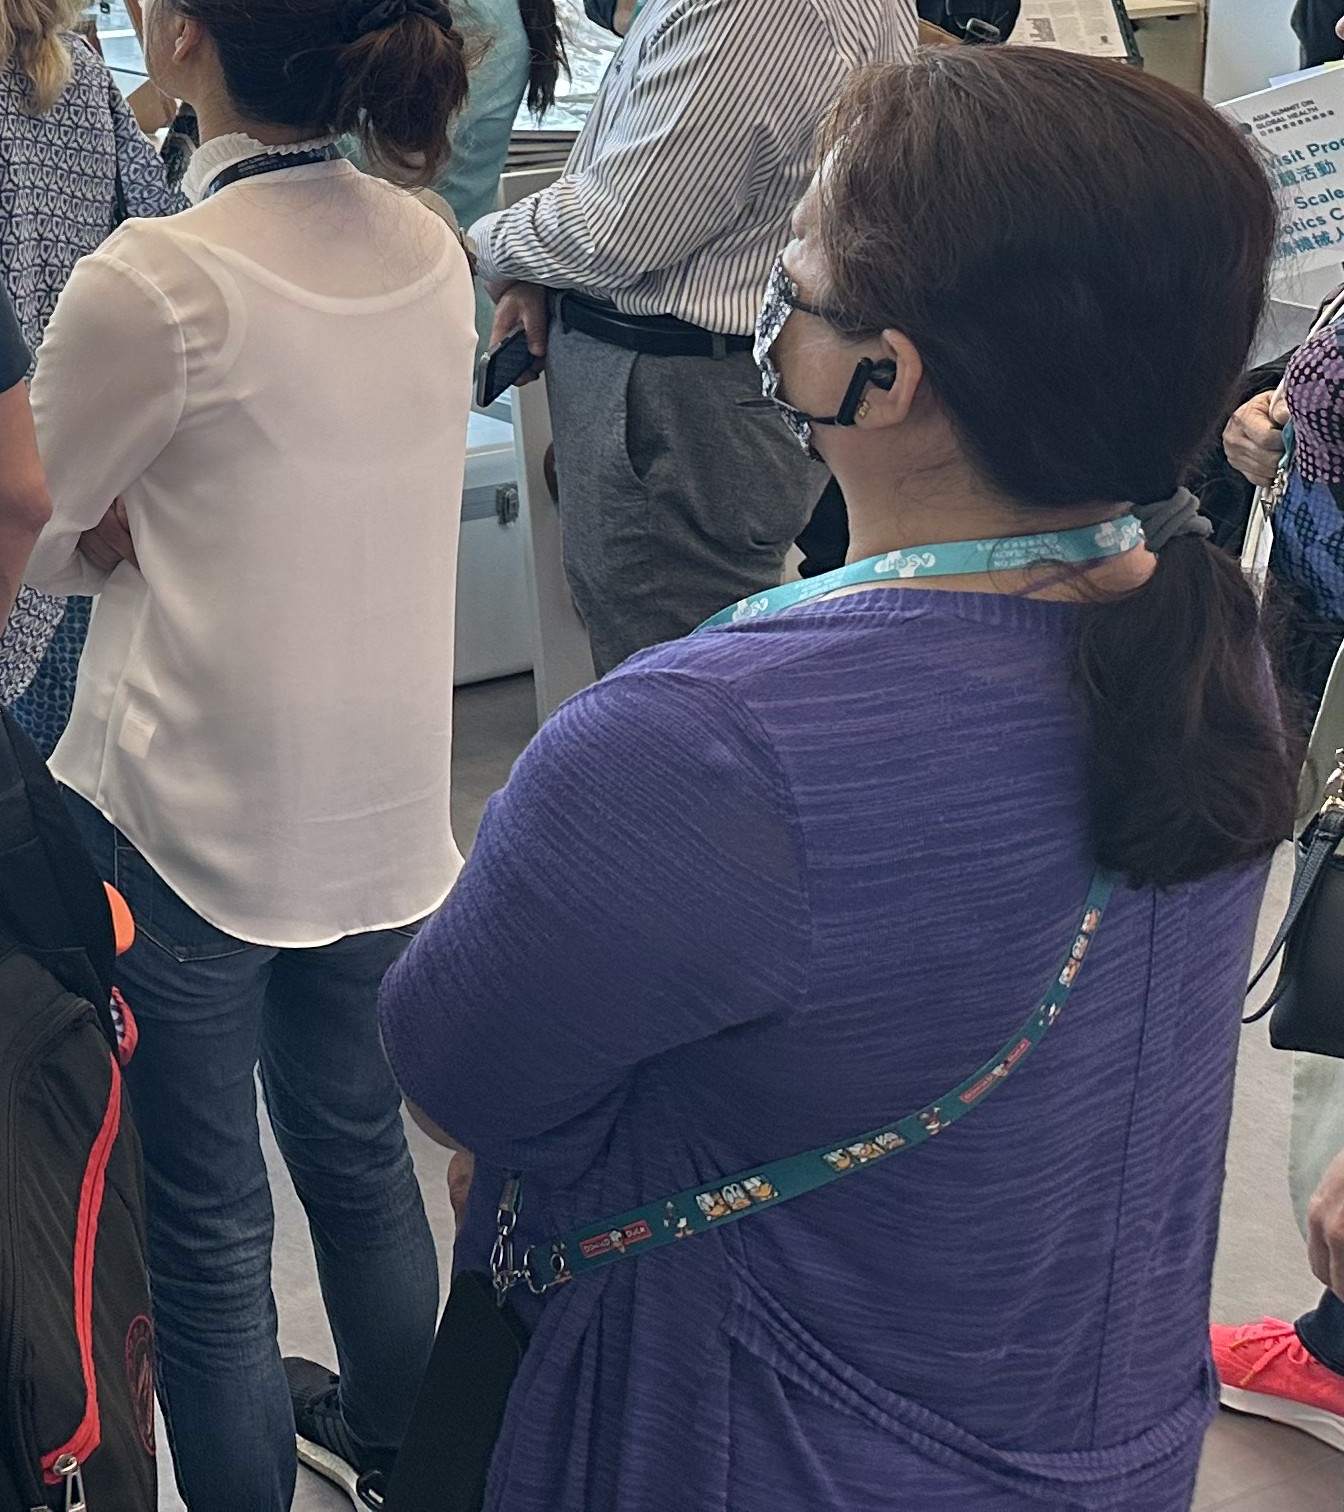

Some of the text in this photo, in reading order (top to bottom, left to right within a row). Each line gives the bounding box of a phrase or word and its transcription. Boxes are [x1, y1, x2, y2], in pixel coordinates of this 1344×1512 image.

[1253, 113, 1270, 122] ASIA
[1271, 103, 1300, 117] SUMMIT
[1256, 116, 1287, 129] GLOBAL
[1287, 106, 1319, 120] HEALTH
[1281, 216, 1327, 236] otics
[887, 554, 932, 570] ASGH
